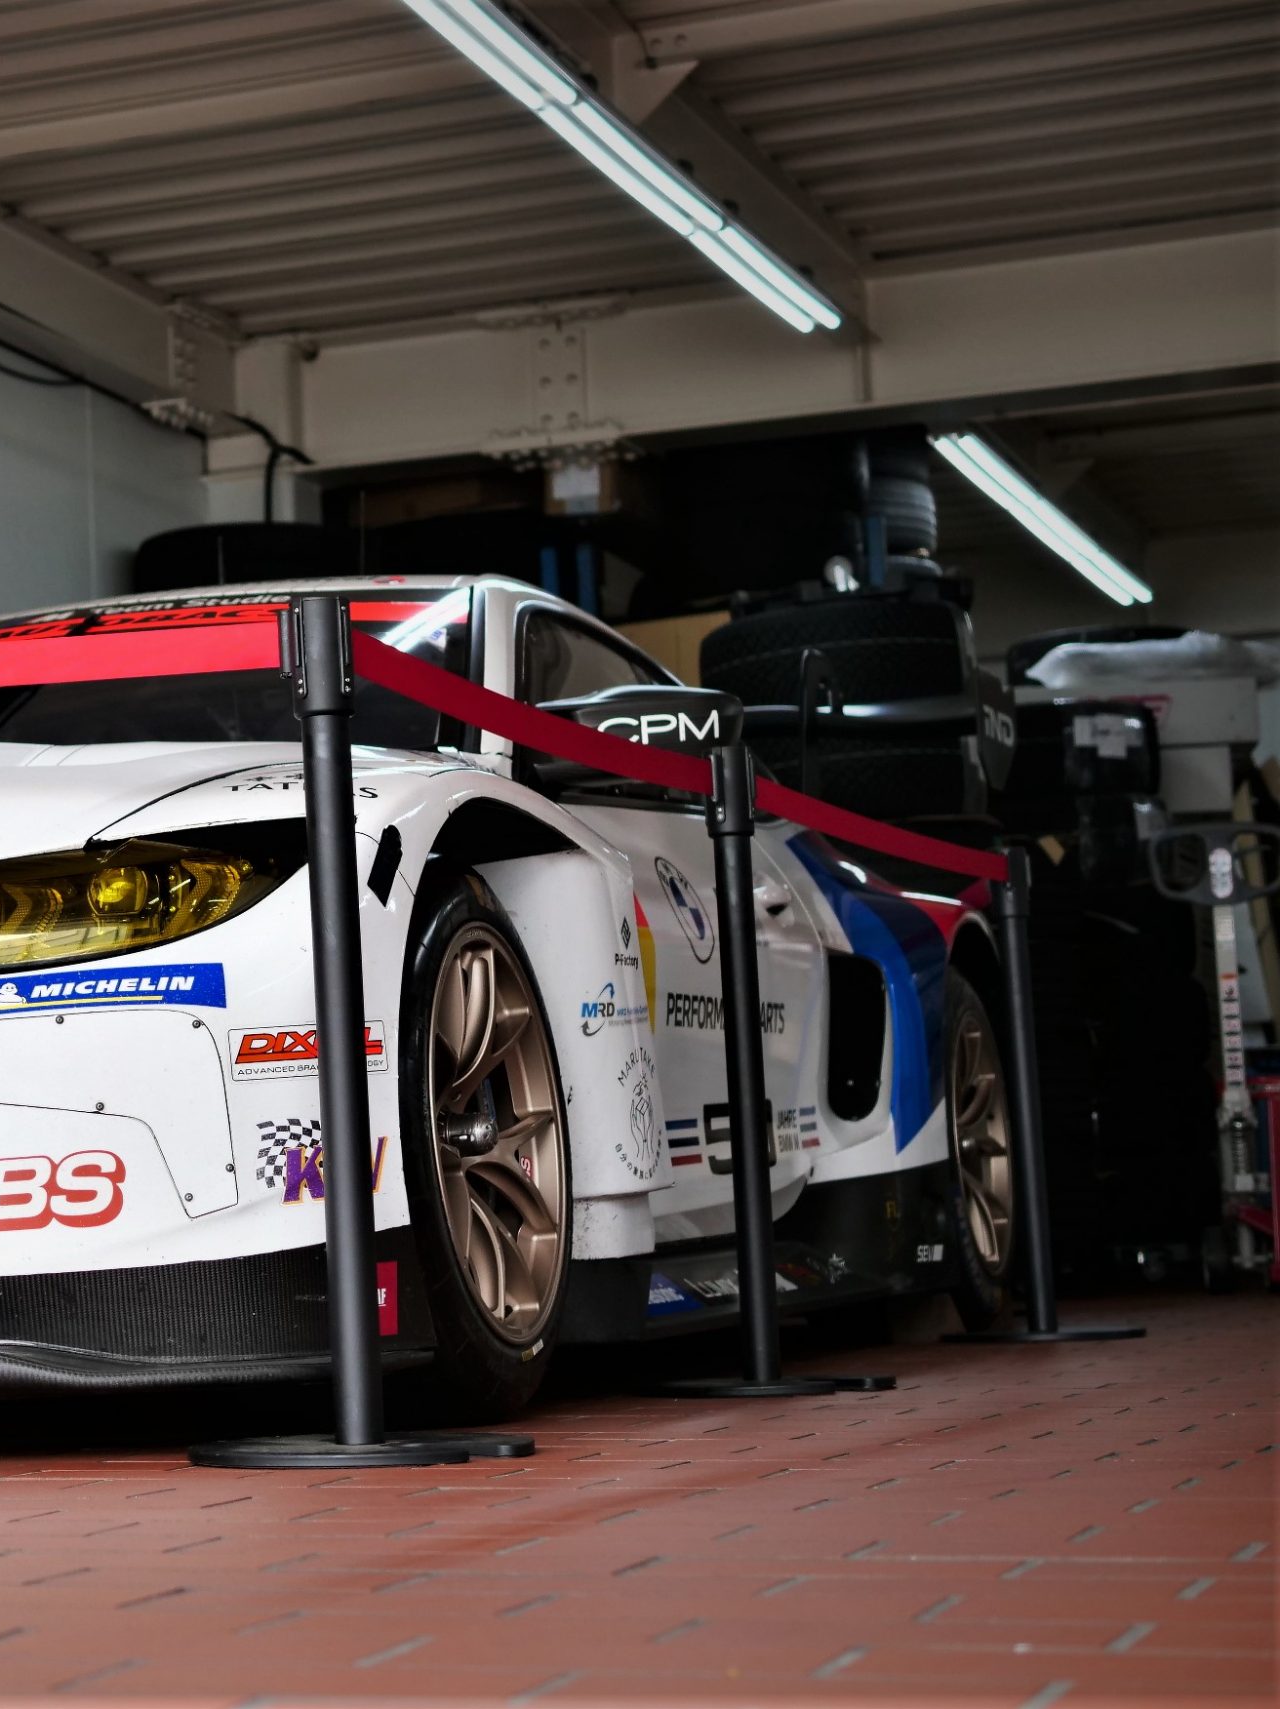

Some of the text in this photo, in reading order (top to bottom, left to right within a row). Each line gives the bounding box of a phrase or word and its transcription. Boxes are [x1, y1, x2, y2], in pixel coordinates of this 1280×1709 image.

[183, 594, 292, 609] Studie
[597, 709, 720, 745] CPM
[223, 782, 378, 799] TATS
[30, 975, 195, 999] MICHELIN
[581, 1002, 615, 1018] MRD
[666, 992, 785, 1034] PERFORM ARTS
[235, 1026, 384, 1064] DIXL
[237, 1065, 297, 1076] ADVANCED
